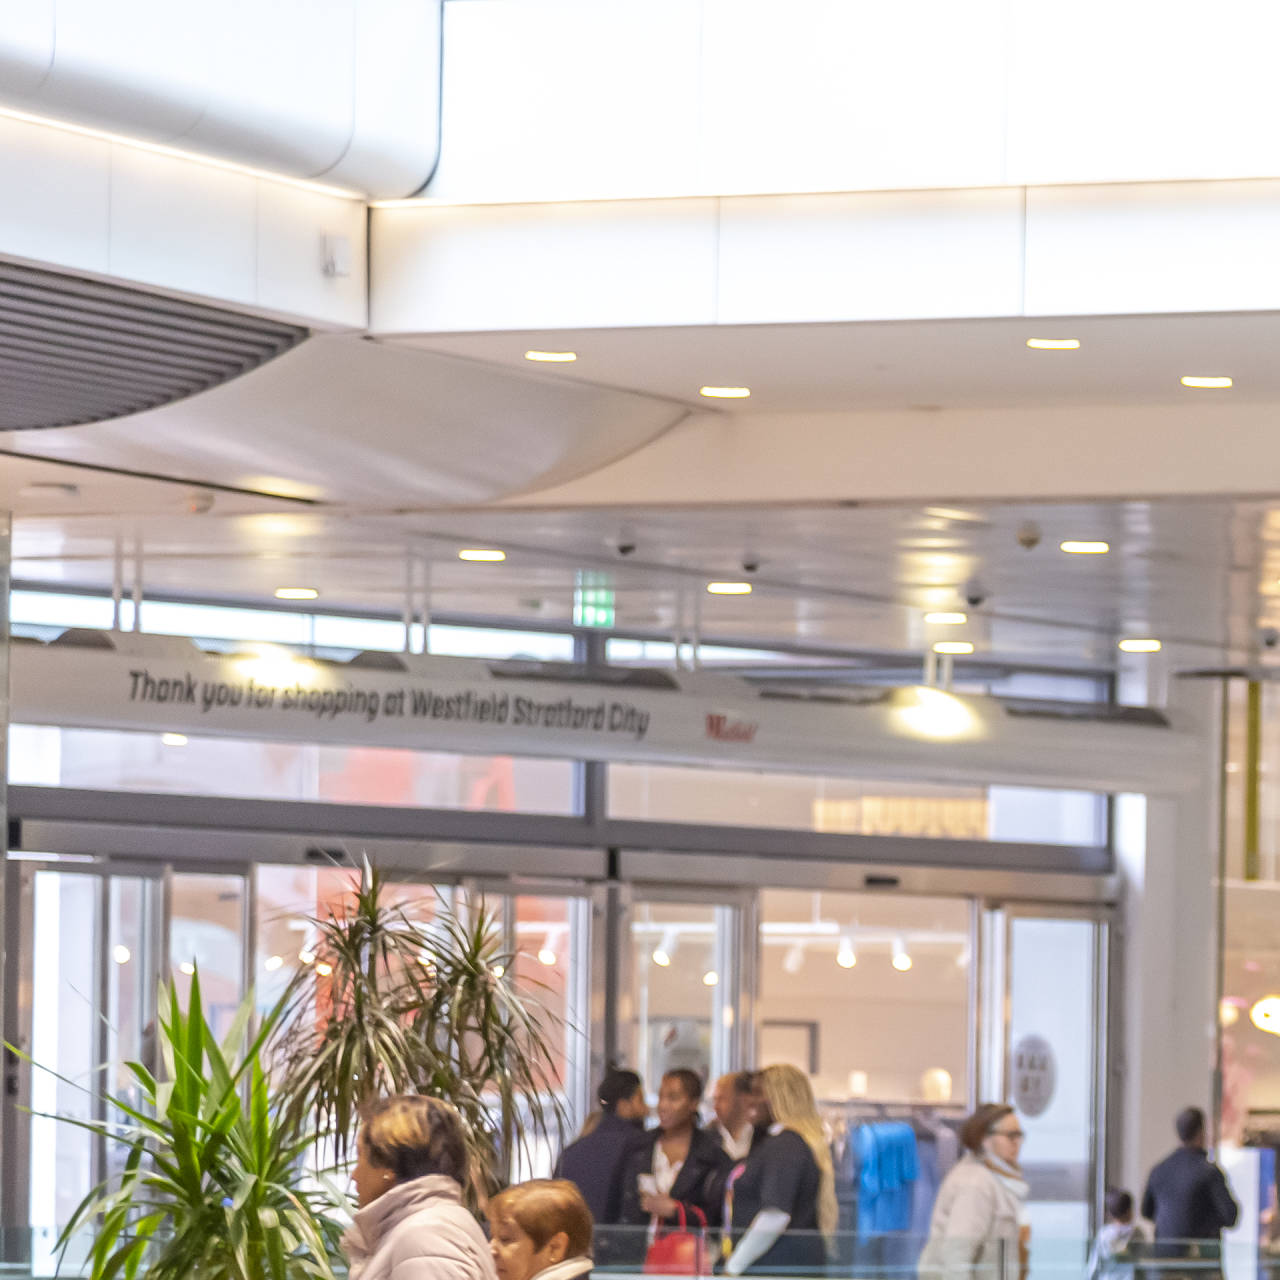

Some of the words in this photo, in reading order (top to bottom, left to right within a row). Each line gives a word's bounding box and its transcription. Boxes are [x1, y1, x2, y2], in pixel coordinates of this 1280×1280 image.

[130, 669, 195, 704] Thank
[202, 681, 242, 713] you
[282, 682, 378, 722] shopping
[384, 689, 404, 718] at
[411, 689, 508, 724] Westfield
[513, 695, 605, 731] Stratford
[609, 702, 649, 742] City
